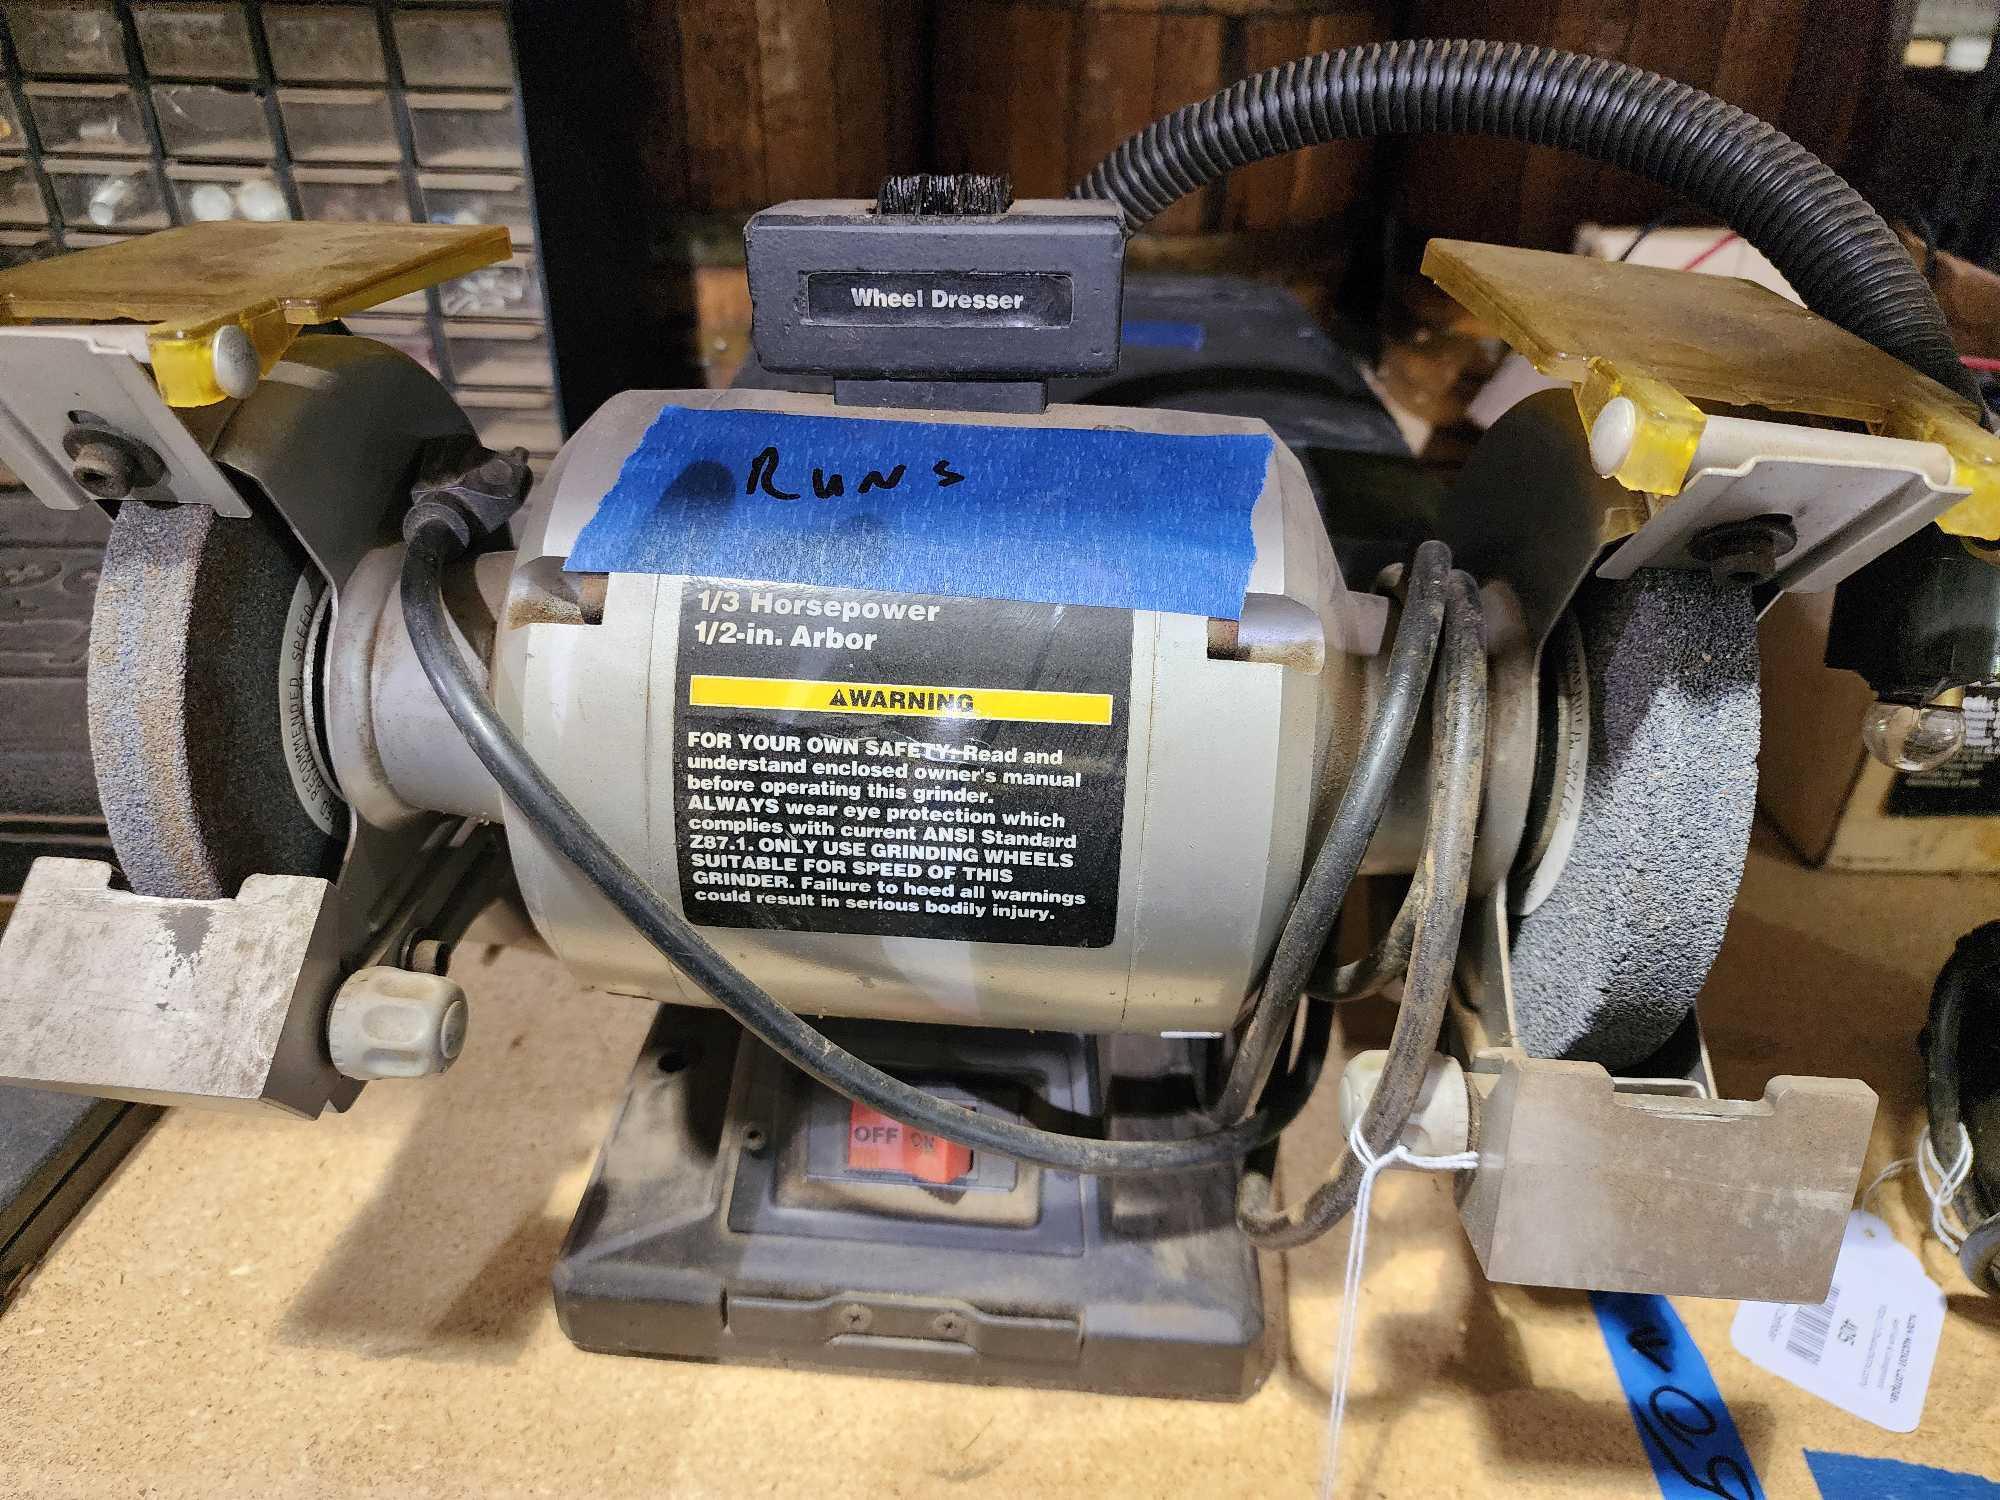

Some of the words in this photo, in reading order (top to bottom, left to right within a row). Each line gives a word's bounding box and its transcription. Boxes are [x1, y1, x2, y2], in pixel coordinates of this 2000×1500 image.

[850, 287, 924, 308] Wheel
[931, 289, 1024, 310] Dresser
[698, 590, 740, 613] 1/3
[750, 591, 940, 622] Horsepower
[695, 620, 783, 646] 1/2-in.
[790, 625, 878, 651] Arbor
[849, 689, 974, 712] WARNING
[288, 676, 319, 802] RECOMMENDED
[687, 732, 732, 749] FOR
[738, 734, 801, 752] YOUR
[806, 737, 860, 755] OWN
[963, 745, 1018, 764] Read
[1023, 749, 1063, 766] and
[687, 755, 807, 774] understand
[812, 761, 908, 779] enclosed
[914, 767, 997, 783] owner's
[1002, 772, 1081, 788] manual
[687, 774, 755, 793] before
[760, 780, 861, 800] operating
[867, 783, 907, 800] this
[913, 786, 994, 804] grinder.
[688, 795, 780, 814] ALWAYS
[785, 802, 839, 817] wear
[843, 805, 881, 821] eye
[886, 806, 995, 825] protection
[1002, 811, 1065, 828] which
[688, 817, 784, 834] complies
[789, 821, 834, 836] with
[840, 824, 917, 840] current
[923, 827, 975, 843] ANSI
[981, 830, 1077, 849] Standard
[689, 834, 754, 851] Z87.1.
[758, 838, 818, 855] ONLY
[823, 841, 866, 857] USE
[871, 843, 979, 863] GRINDING
[984, 849, 1074, 868] WHEELS
[690, 853, 798, 872] SUITABLE
[803, 858, 847, 874] FOR
[852, 861, 923, 878] SPEED
[927, 864, 957, 880] OF
[962, 866, 1014, 883] THIS
[692, 871, 795, 889] GRINDER.
[801, 876, 871, 893] Failure
[877, 880, 899, 895] to
[903, 881, 955, 898] heed
[959, 885, 985, 899] all
[991, 889, 1086, 907] warnings
[694, 889, 751, 903] could
[756, 893, 815, 906] result
[820, 895, 840, 909] in
[845, 897, 920, 912] serious
[925, 899, 986, 918] bodily
[992, 903, 1055, 922] injury.
[854, 1125, 898, 1146] OFF
[911, 1132, 935, 1149] ON
